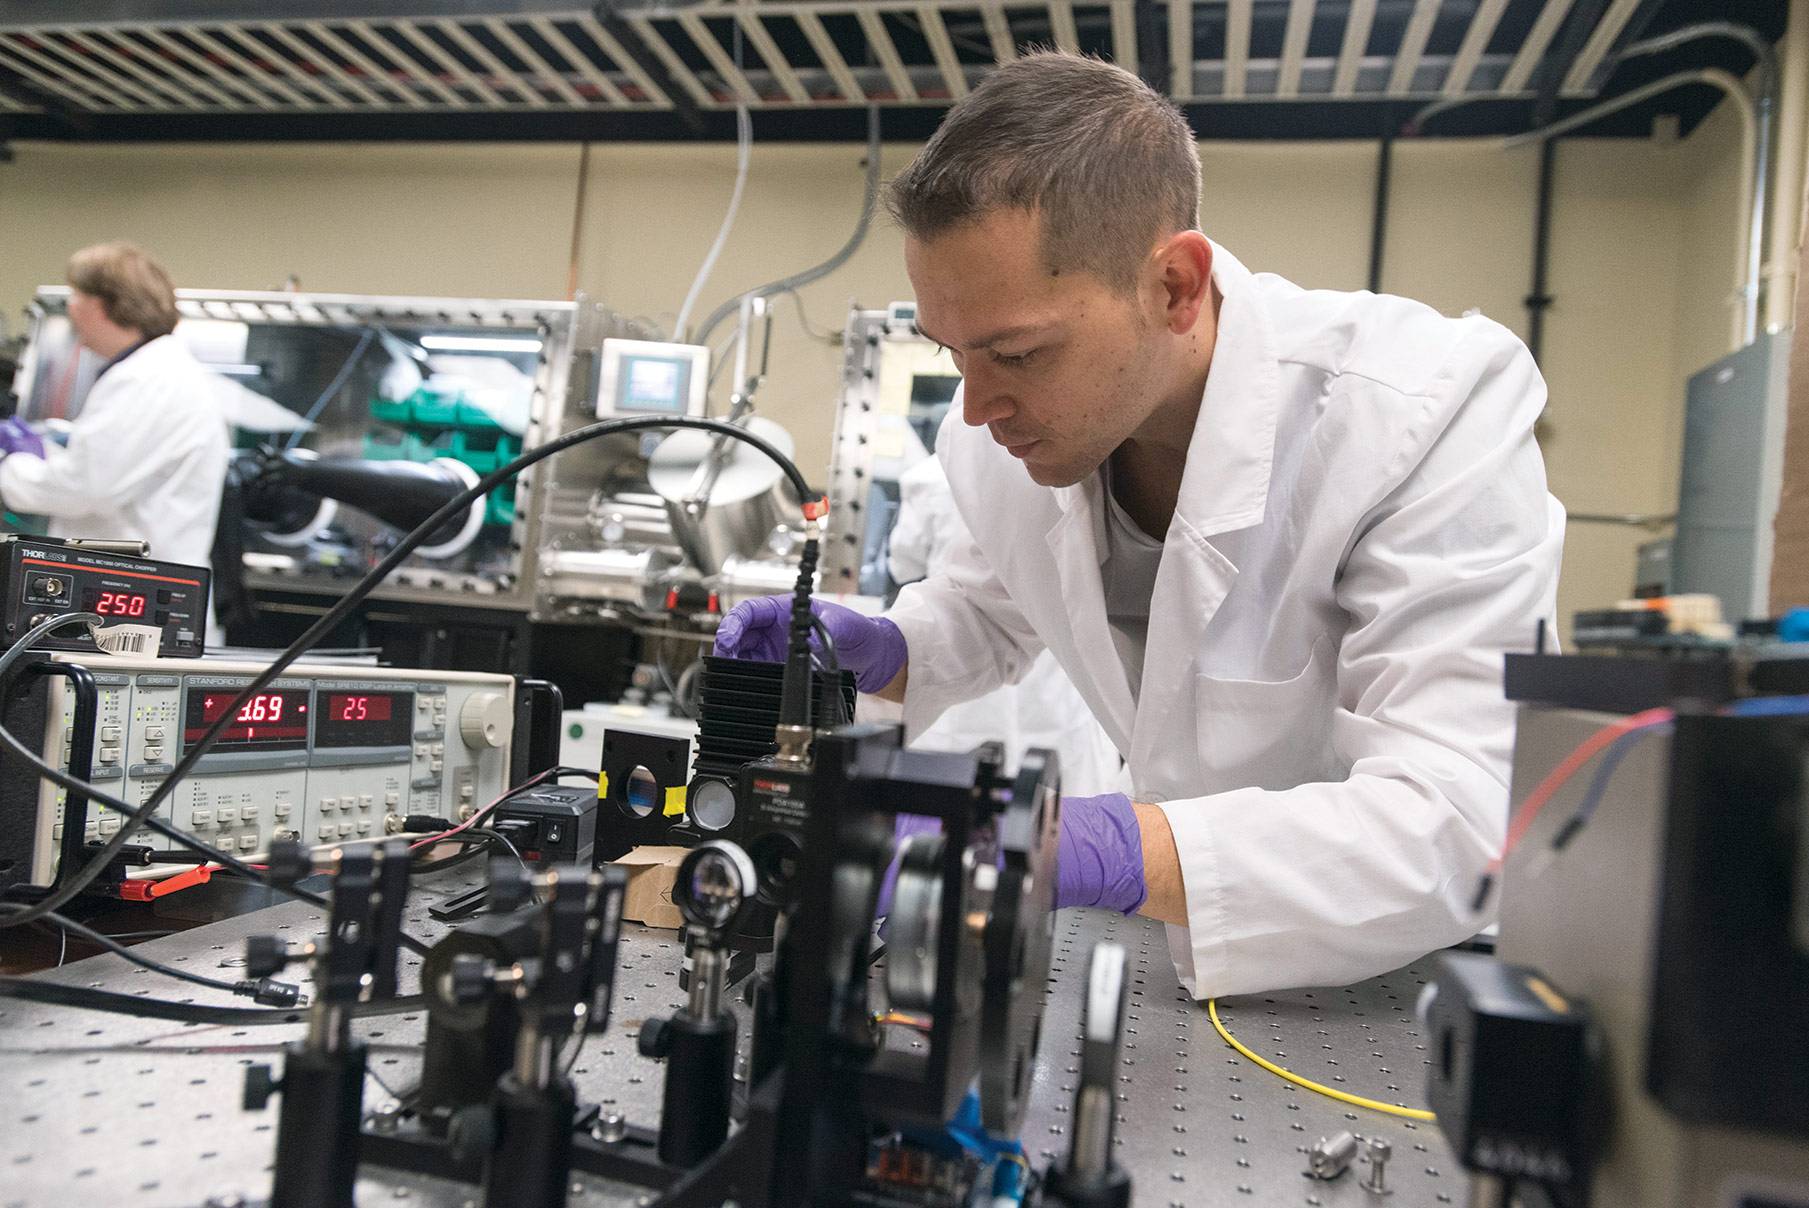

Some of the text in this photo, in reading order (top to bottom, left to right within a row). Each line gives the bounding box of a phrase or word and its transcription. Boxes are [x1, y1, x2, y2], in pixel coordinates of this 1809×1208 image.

[97, 593, 145, 616] 250
[189, 677, 235, 685] STANFORD
[343, 698, 368, 720] 25
